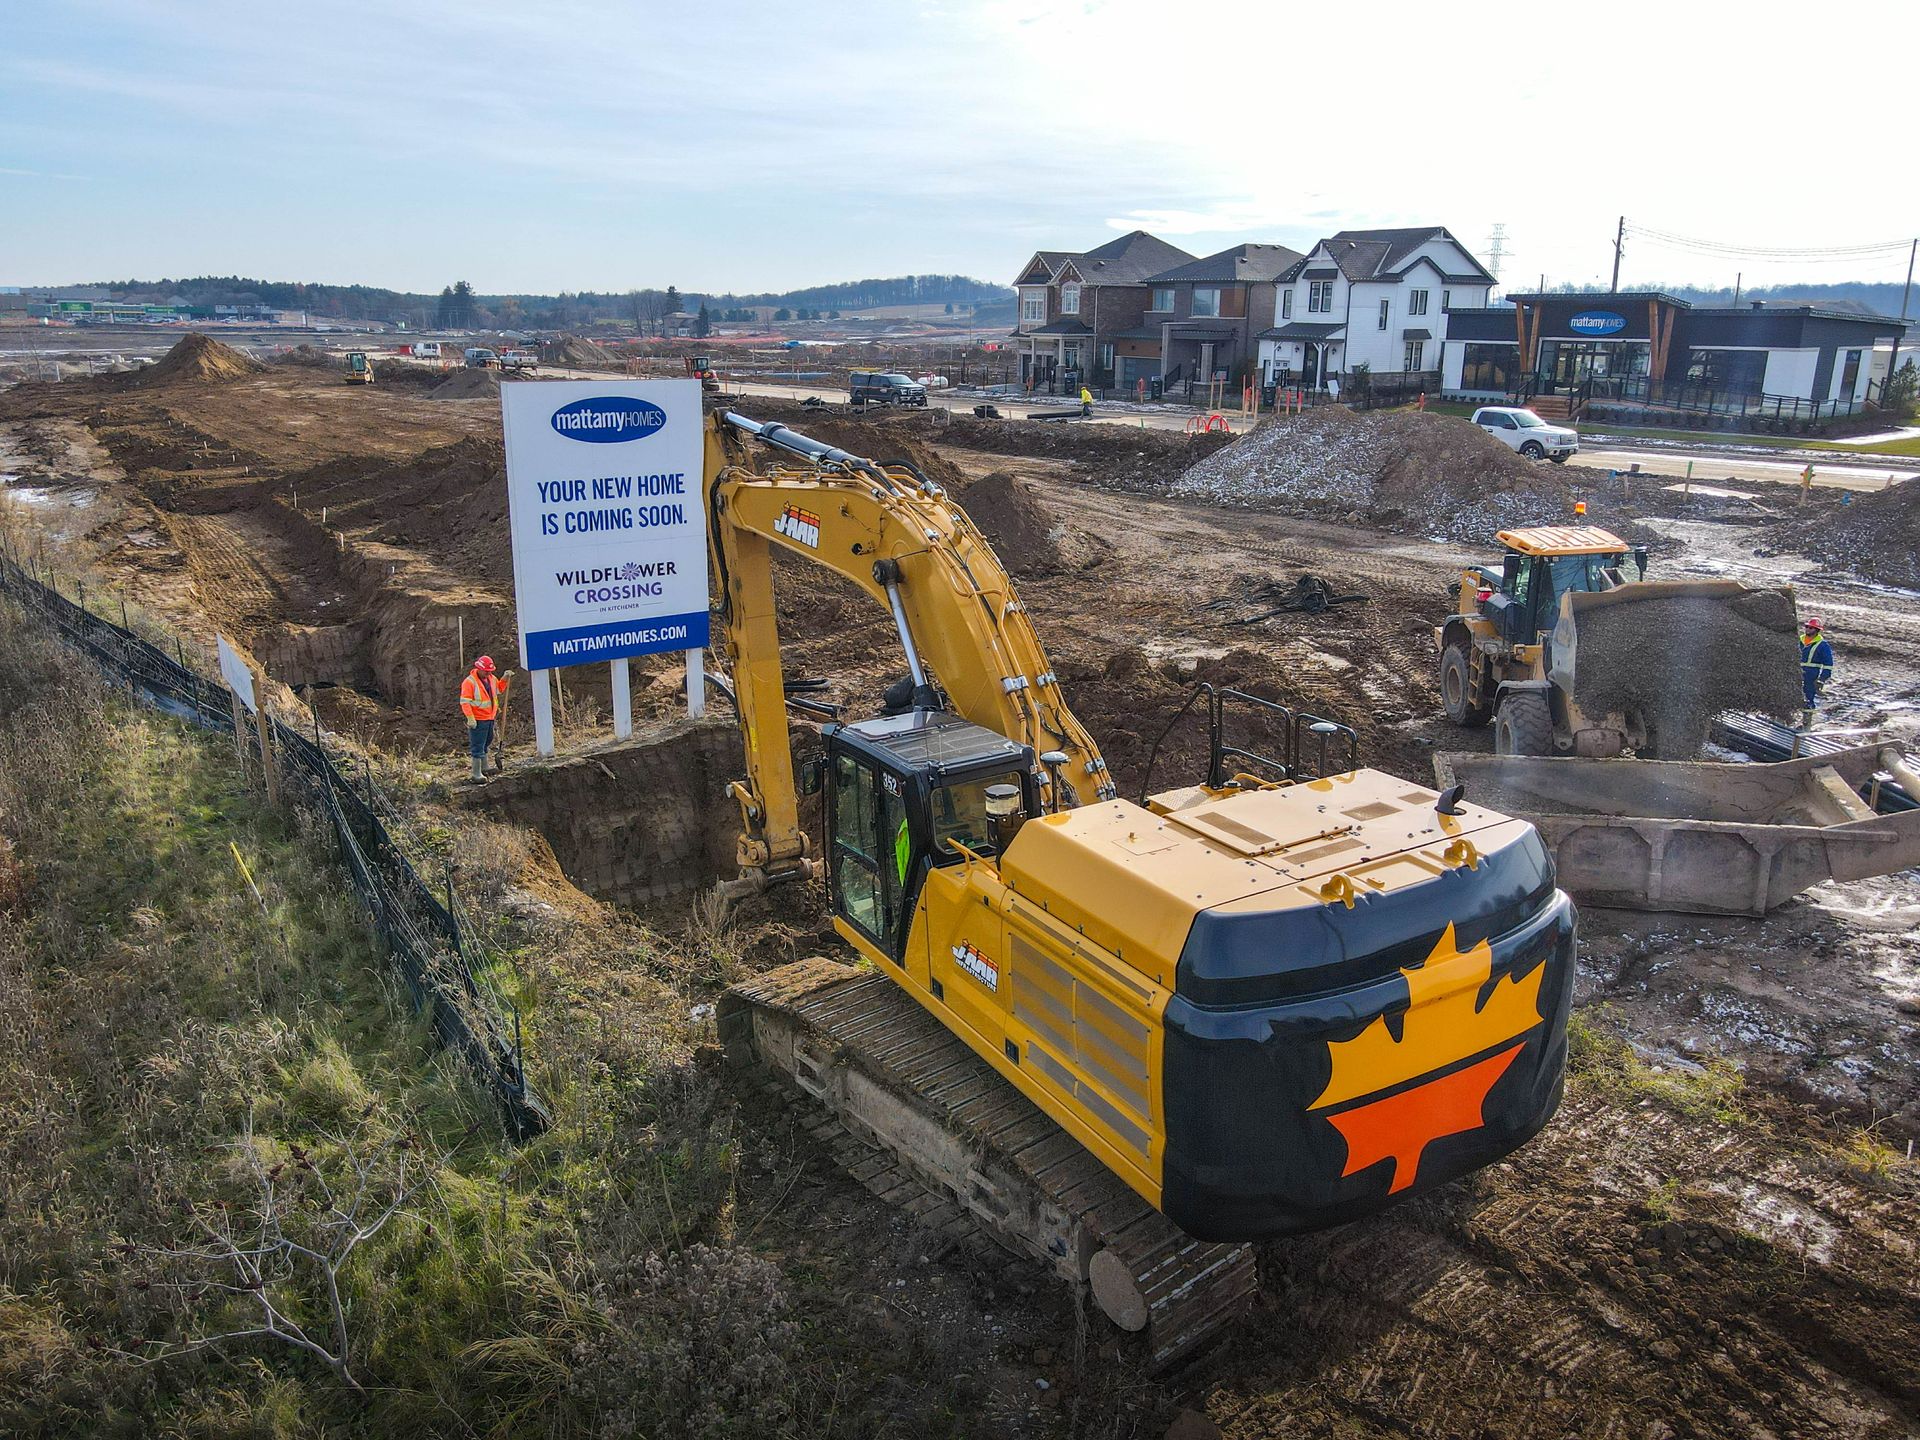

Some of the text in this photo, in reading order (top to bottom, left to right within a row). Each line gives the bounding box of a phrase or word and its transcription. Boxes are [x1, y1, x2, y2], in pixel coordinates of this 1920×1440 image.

[556, 409, 662, 432] mattamyHOMES
[537, 473, 686, 504] YOUR NEW HOME
[541, 504, 688, 535] IS COMING SOON.
[574, 582, 663, 604] CROSSING
[608, 603, 640, 612] KITCHENER
[552, 625, 687, 655] MATTAMYHOMES.COM
[882, 772, 898, 794] 352
